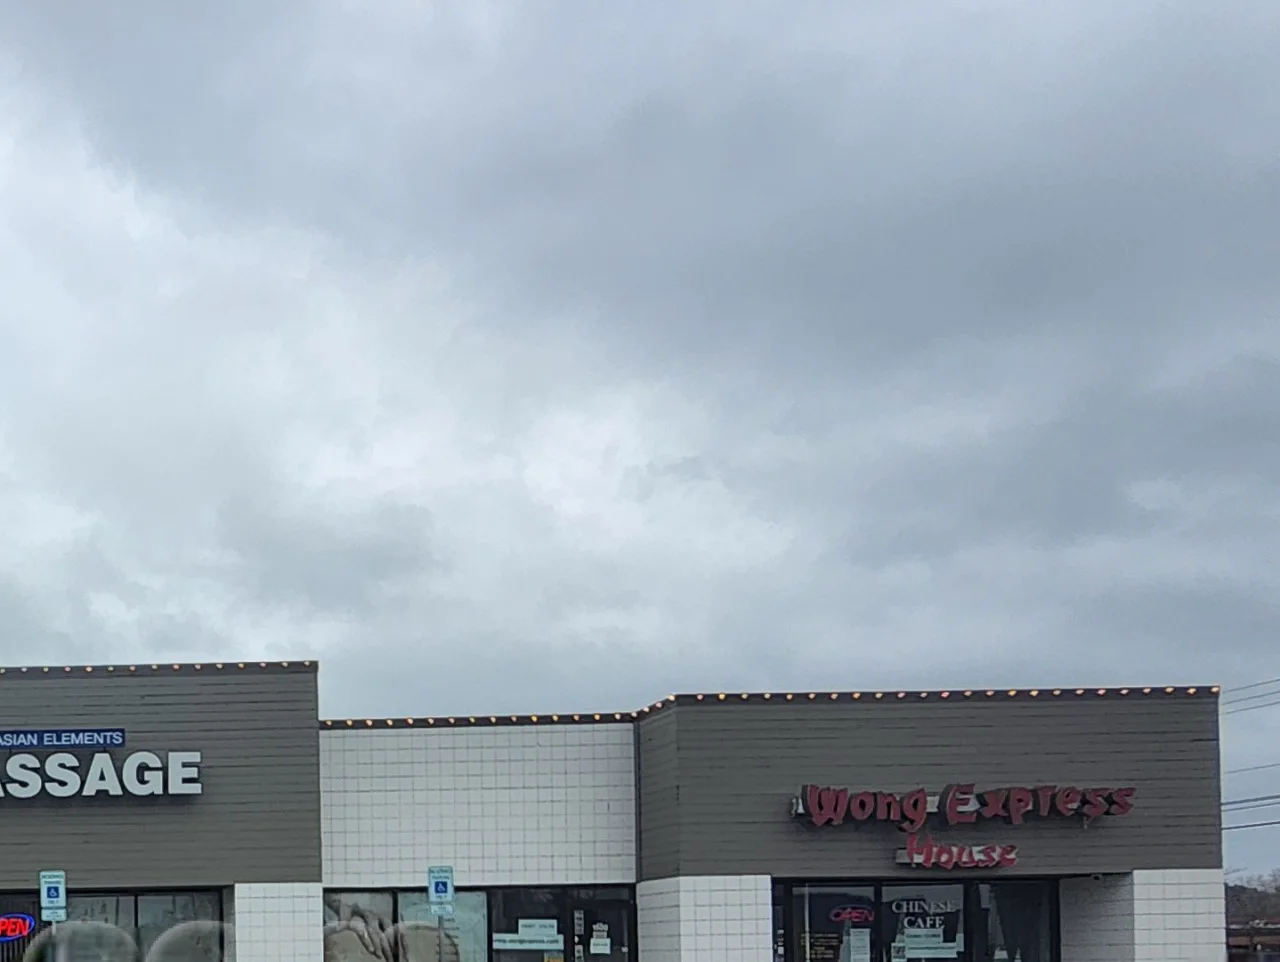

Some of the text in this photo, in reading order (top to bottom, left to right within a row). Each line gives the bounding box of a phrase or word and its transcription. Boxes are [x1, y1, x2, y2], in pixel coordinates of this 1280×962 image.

[43, 731, 123, 746] ELEMENTS
[804, 783, 1136, 833] Wong Express
[905, 834, 1019, 871] House
[891, 900, 956, 914] CHINESE
[903, 915, 946, 930] CAFE
